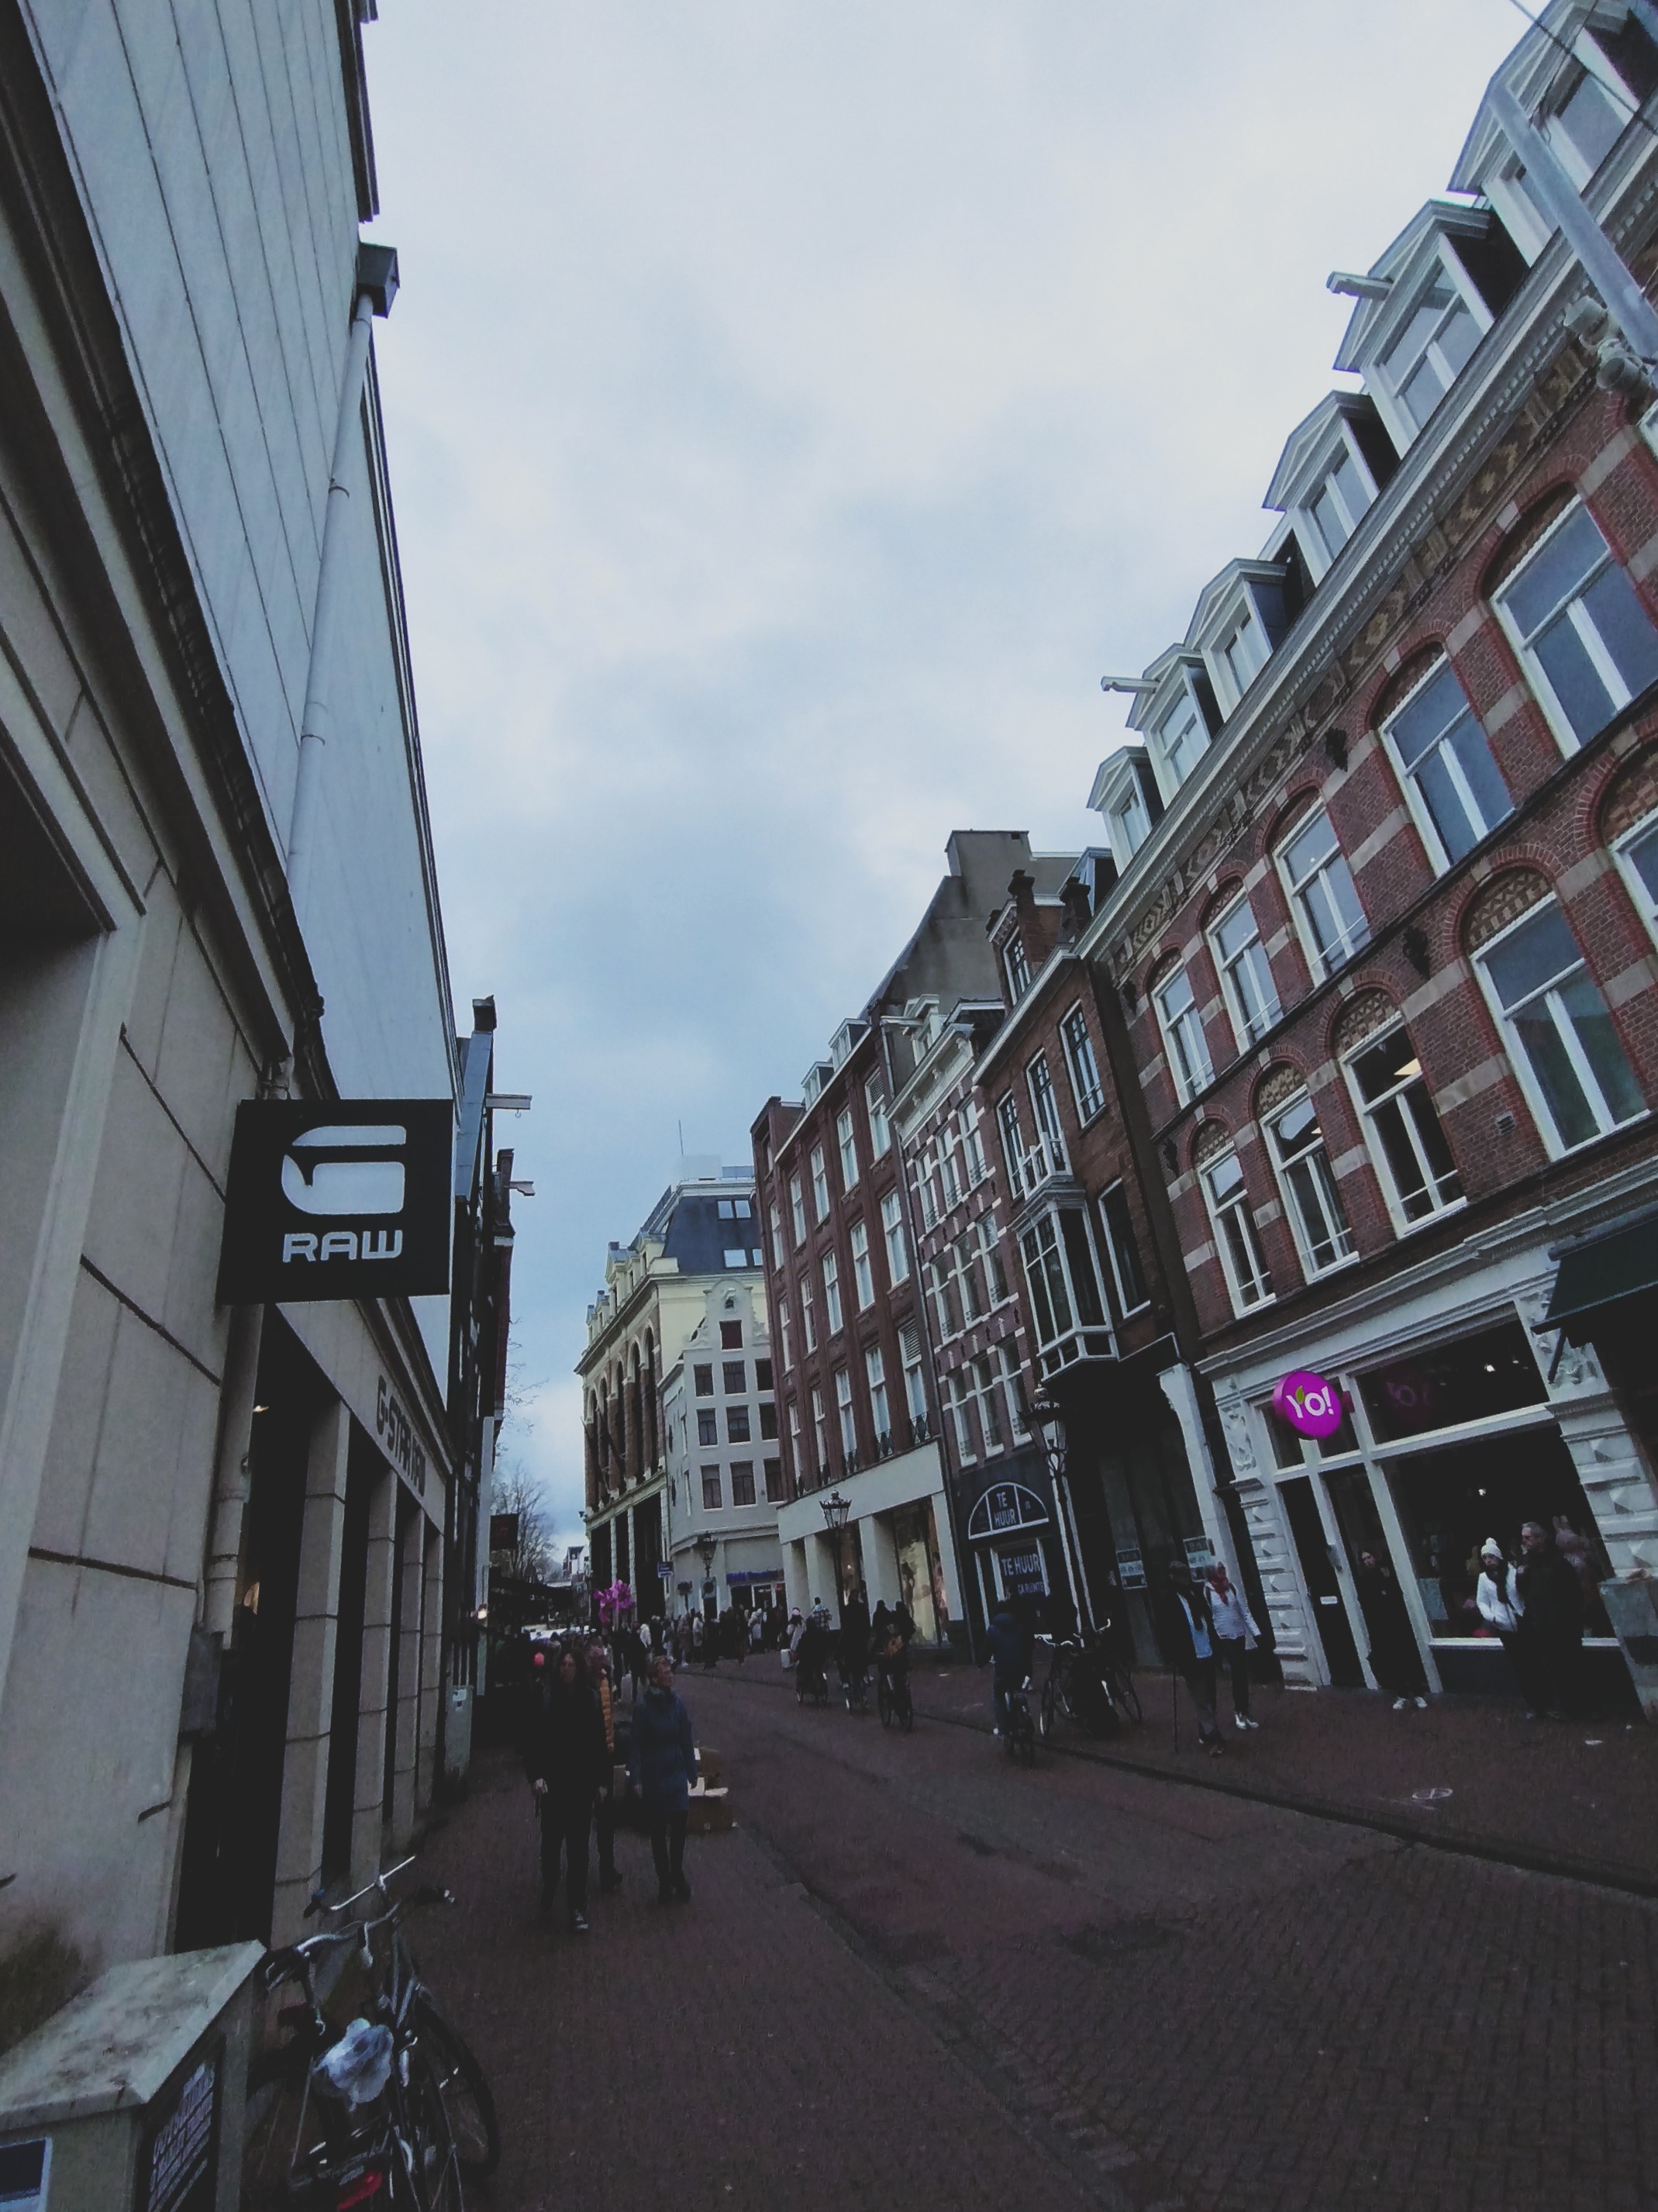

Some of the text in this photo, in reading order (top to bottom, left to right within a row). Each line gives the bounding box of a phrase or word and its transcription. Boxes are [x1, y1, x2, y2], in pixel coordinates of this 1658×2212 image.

[282, 1230, 403, 1263] RAW
[1286, 1386, 1334, 1419] YO!
[996, 1491, 1008, 1508] TE
[994, 1508, 1017, 1527] HUUR
[1001, 1553, 1041, 1576] TE HUUR
